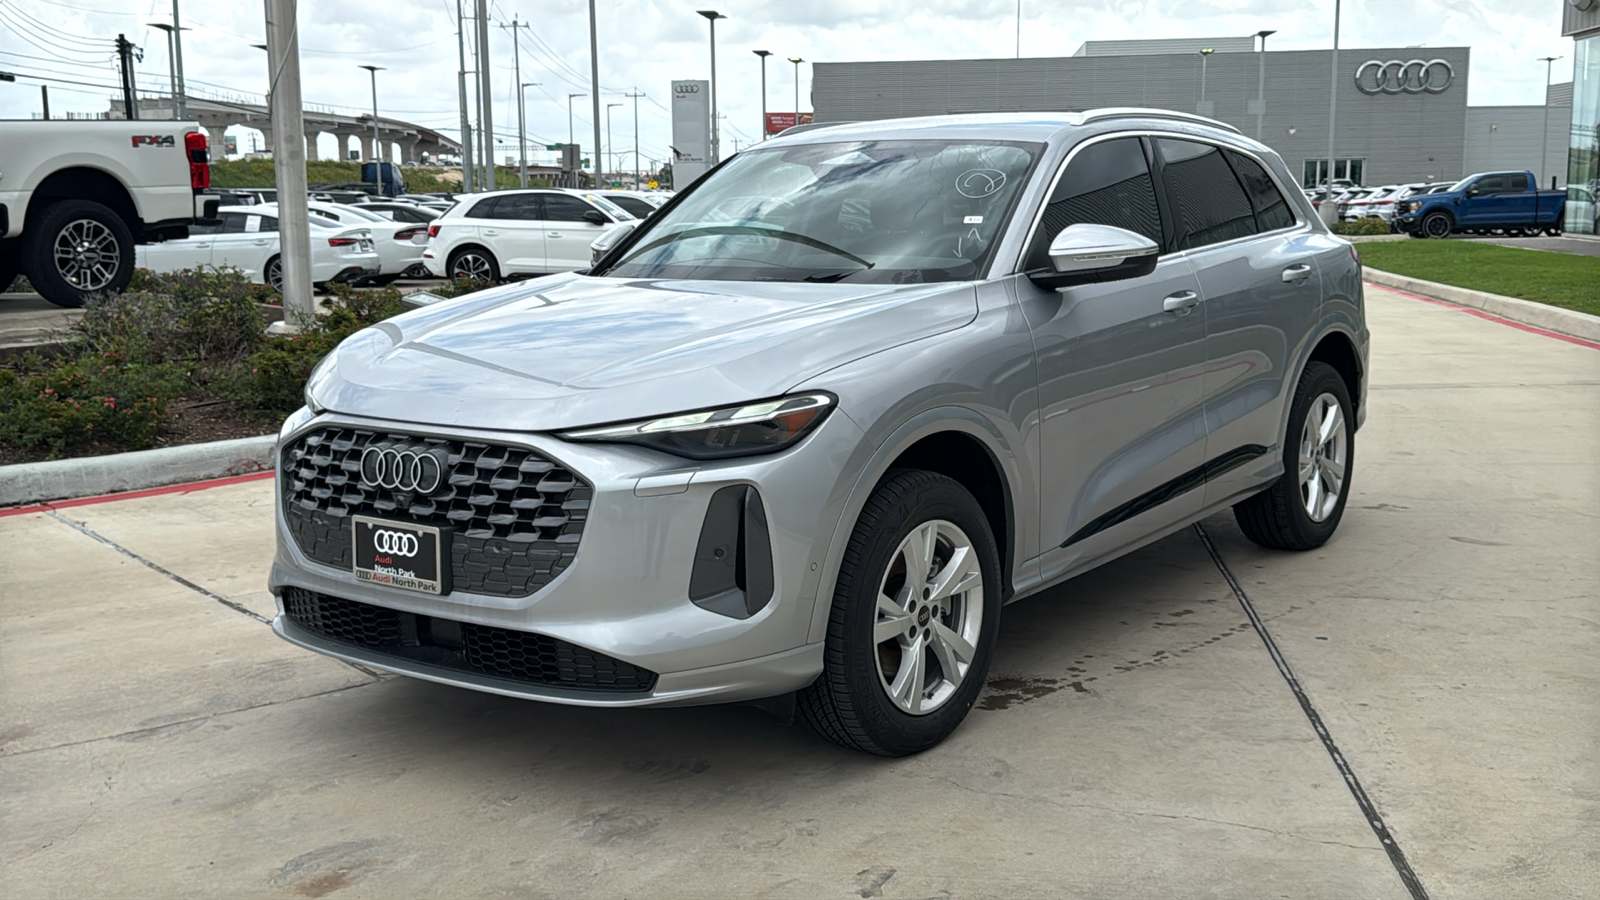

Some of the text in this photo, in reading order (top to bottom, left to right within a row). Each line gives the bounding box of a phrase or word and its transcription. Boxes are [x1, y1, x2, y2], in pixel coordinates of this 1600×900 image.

[132, 135, 175, 148] FX4
[375, 554, 392, 564] Audi
[374, 564, 416, 578] North Park
[373, 573, 437, 592] Audi North Park
